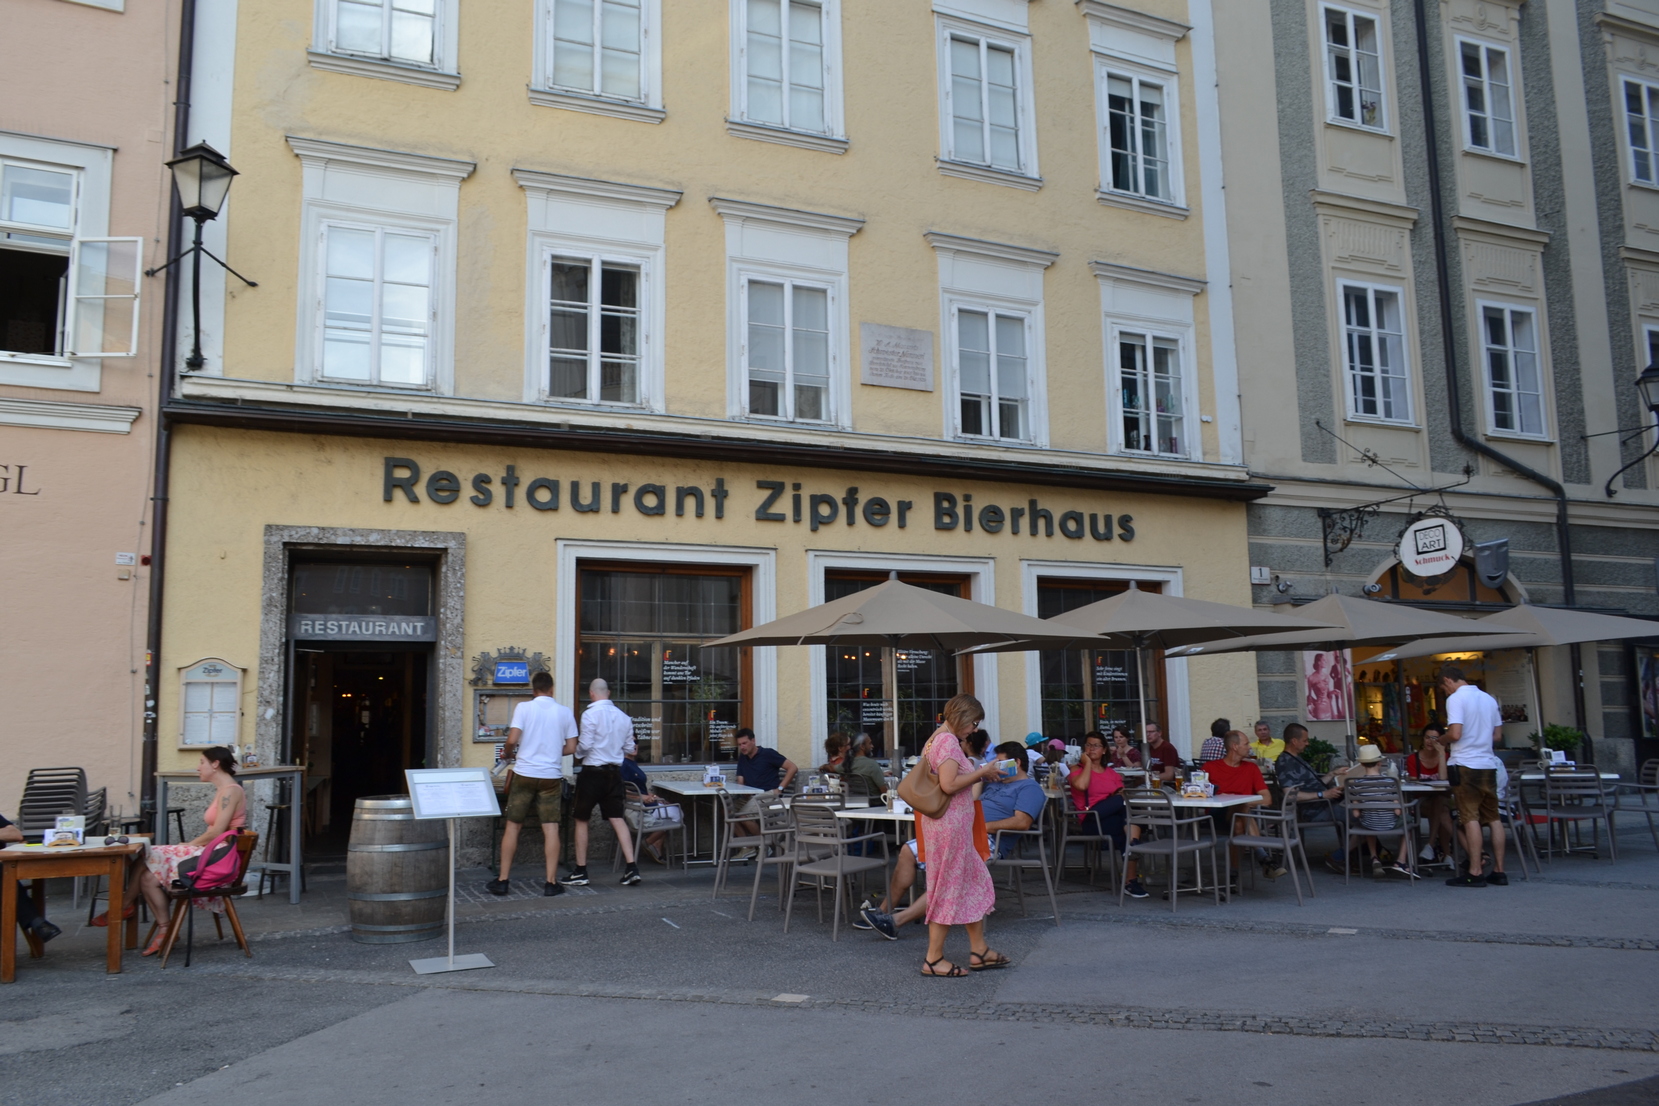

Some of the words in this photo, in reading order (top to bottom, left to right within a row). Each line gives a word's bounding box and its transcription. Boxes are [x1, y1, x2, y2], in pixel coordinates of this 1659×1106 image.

[383, 456, 729, 519] Restaurant
[755, 479, 913, 532] Zipfer
[933, 491, 1135, 542] Bierhaus
[1419, 528, 1440, 540] DECO
[1420, 539, 1442, 551] ART
[1414, 553, 1451, 566] Schmuck
[1259, 567, 1263, 578] 1
[301, 620, 425, 636] RESTAURANT
[202, 666, 223, 674] Zipfer
[497, 666, 527, 678] Zipfer
